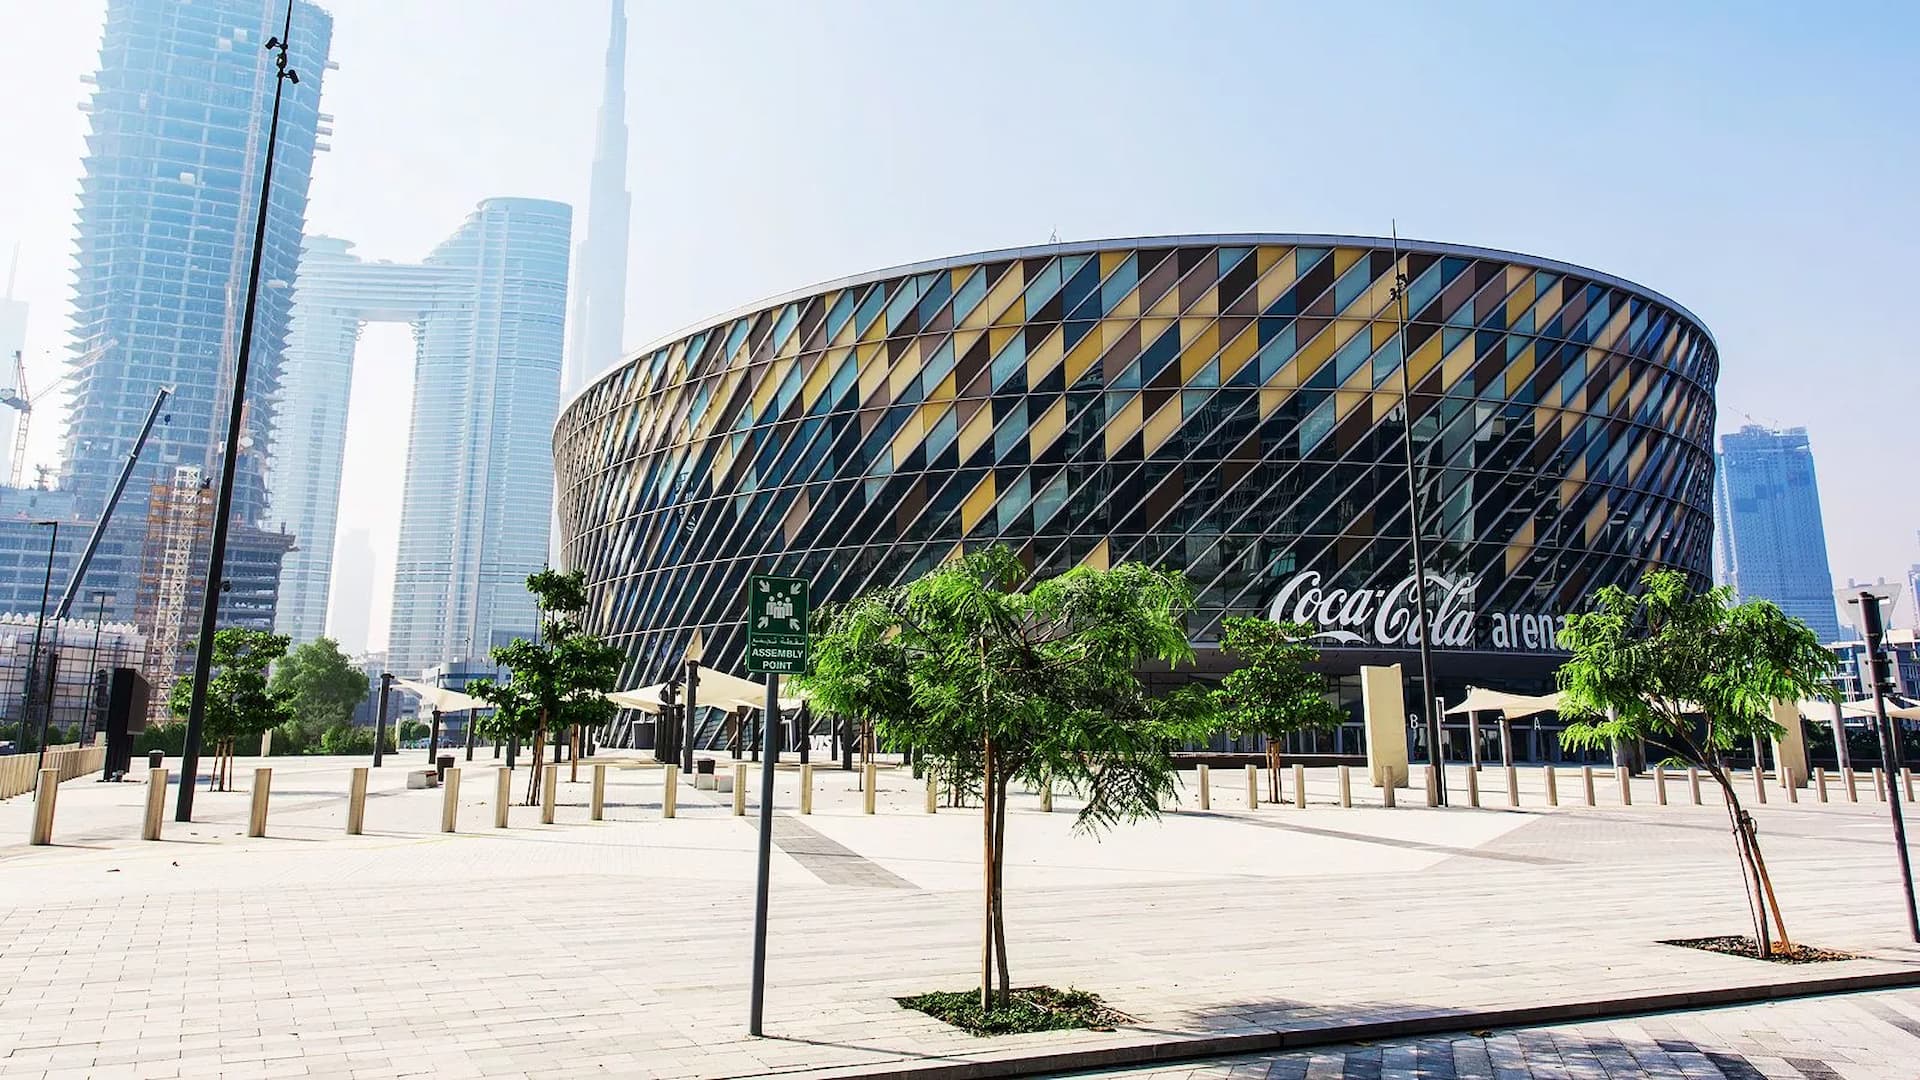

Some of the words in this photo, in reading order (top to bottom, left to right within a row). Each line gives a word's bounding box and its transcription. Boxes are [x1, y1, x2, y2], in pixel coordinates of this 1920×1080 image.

[1269, 570, 1484, 646] Coca-Cola
[751, 648, 803, 659] ASSEMBLY
[762, 660, 793, 670] POINT
[1409, 713, 1418, 729] B
[1533, 716, 1541, 731] A
